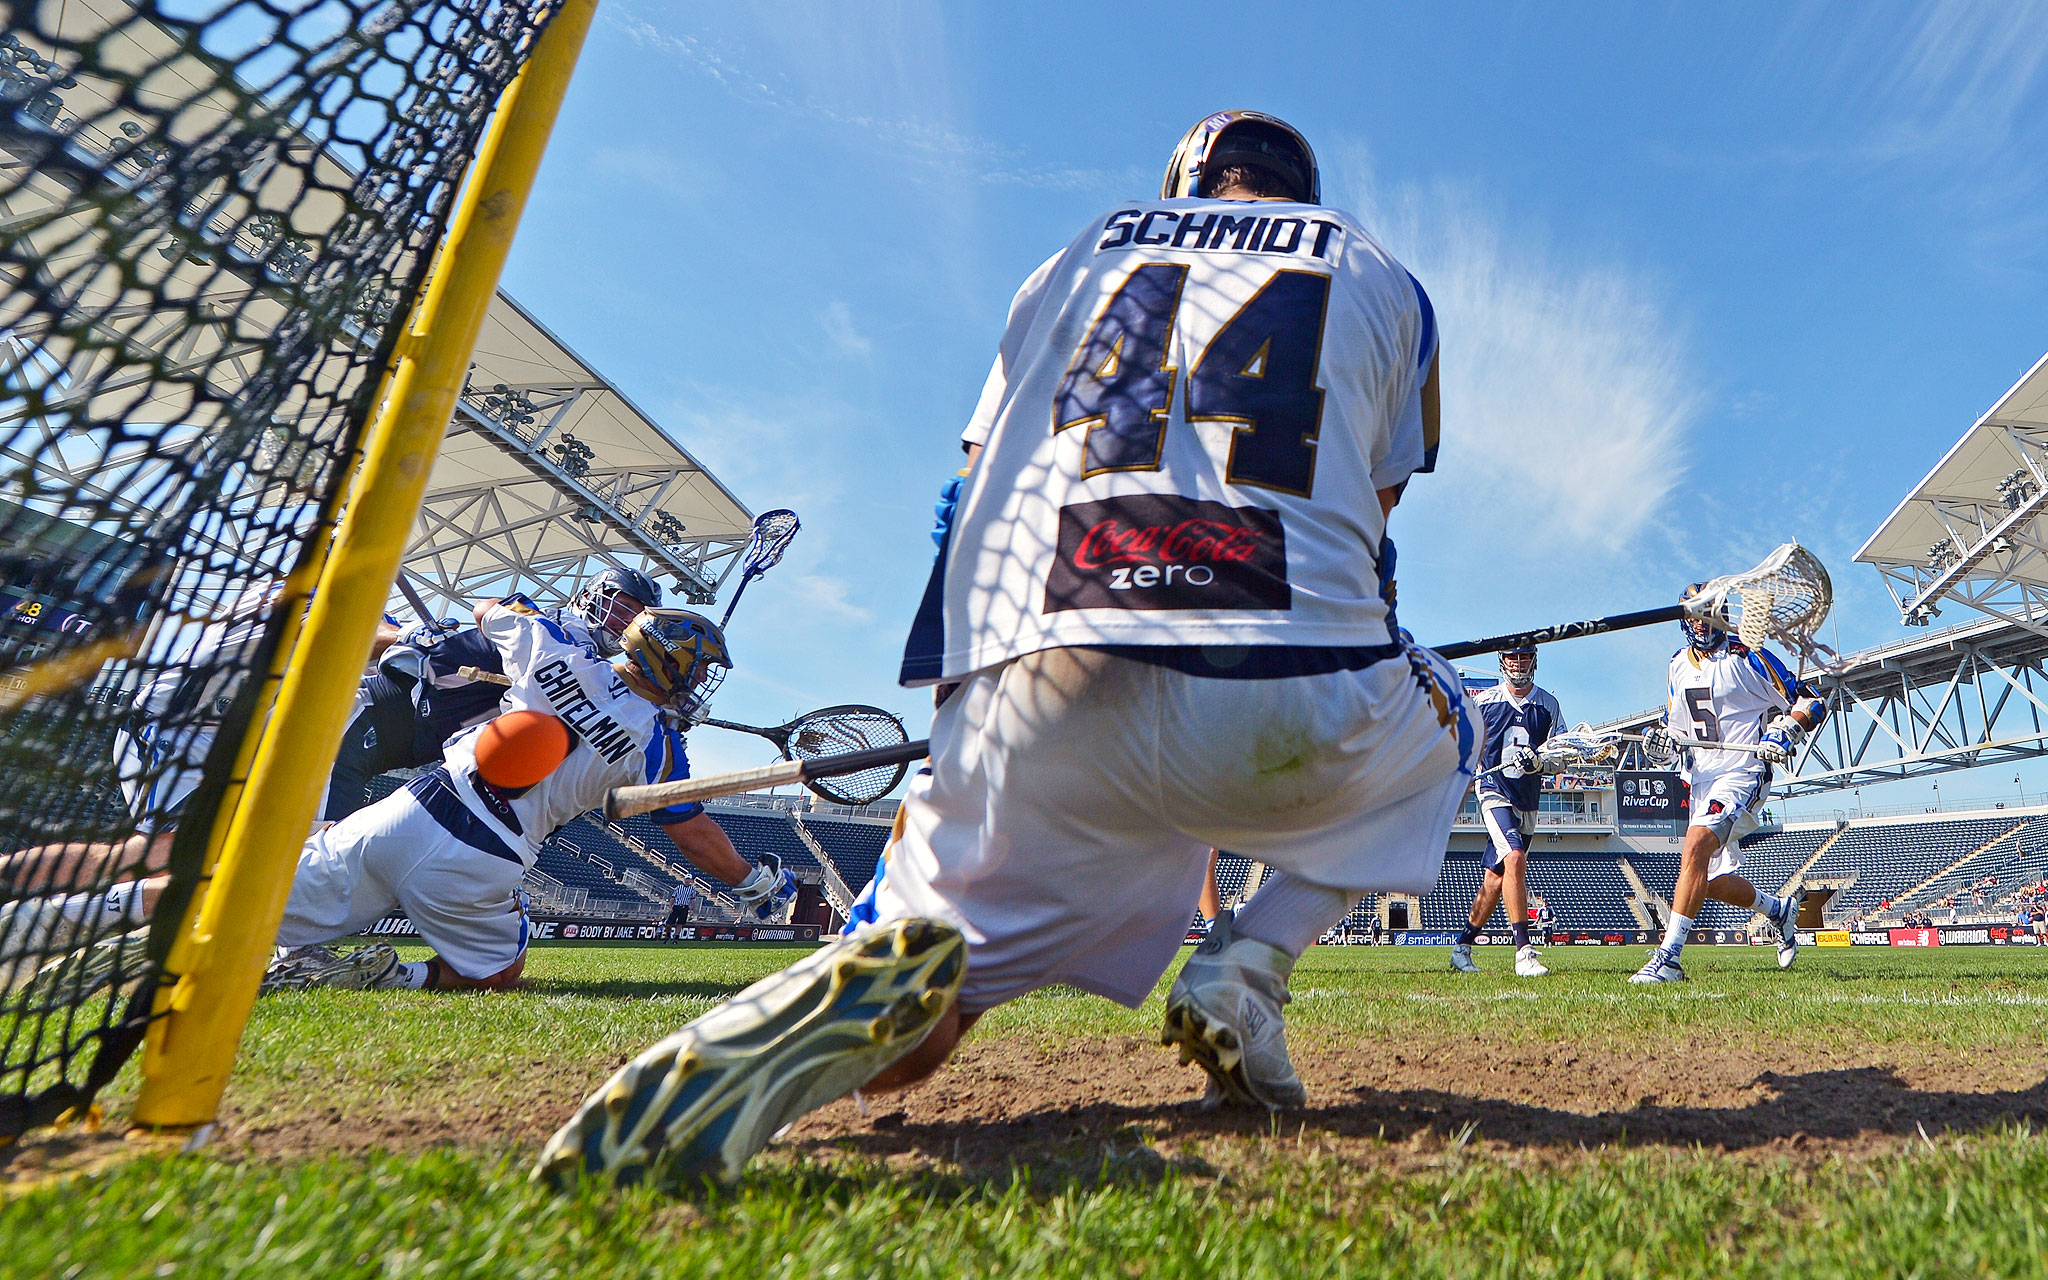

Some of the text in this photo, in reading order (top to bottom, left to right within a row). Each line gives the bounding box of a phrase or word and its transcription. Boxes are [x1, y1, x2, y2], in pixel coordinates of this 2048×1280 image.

[1207, 113, 1231, 130] MY
[1100, 209, 1342, 259] SCHMIDT
[1053, 262, 1332, 500] 44
[1073, 518, 1264, 570] Coca-Cola
[1108, 562, 1214, 590] zero
[12, 614, 38, 625] HOT
[640, 620, 681, 653] HOUNDS
[534, 660, 637, 765] GHITELMAN
[1685, 687, 1719, 742] 5
[1622, 796, 1669, 809] RiverCup
[580, 925, 602, 938] BODY
[603, 926, 613, 938] BY
[614, 926, 635, 938] JAKE
[757, 929, 795, 940] WARRIOR
[1850, 932, 1890, 945] POWERADE
[1945, 930, 1989, 944] WARRIOR
[1407, 934, 1457, 945] smartlink
[1491, 935, 1513, 945] BODY
[1574, 938, 1601, 946] everything
